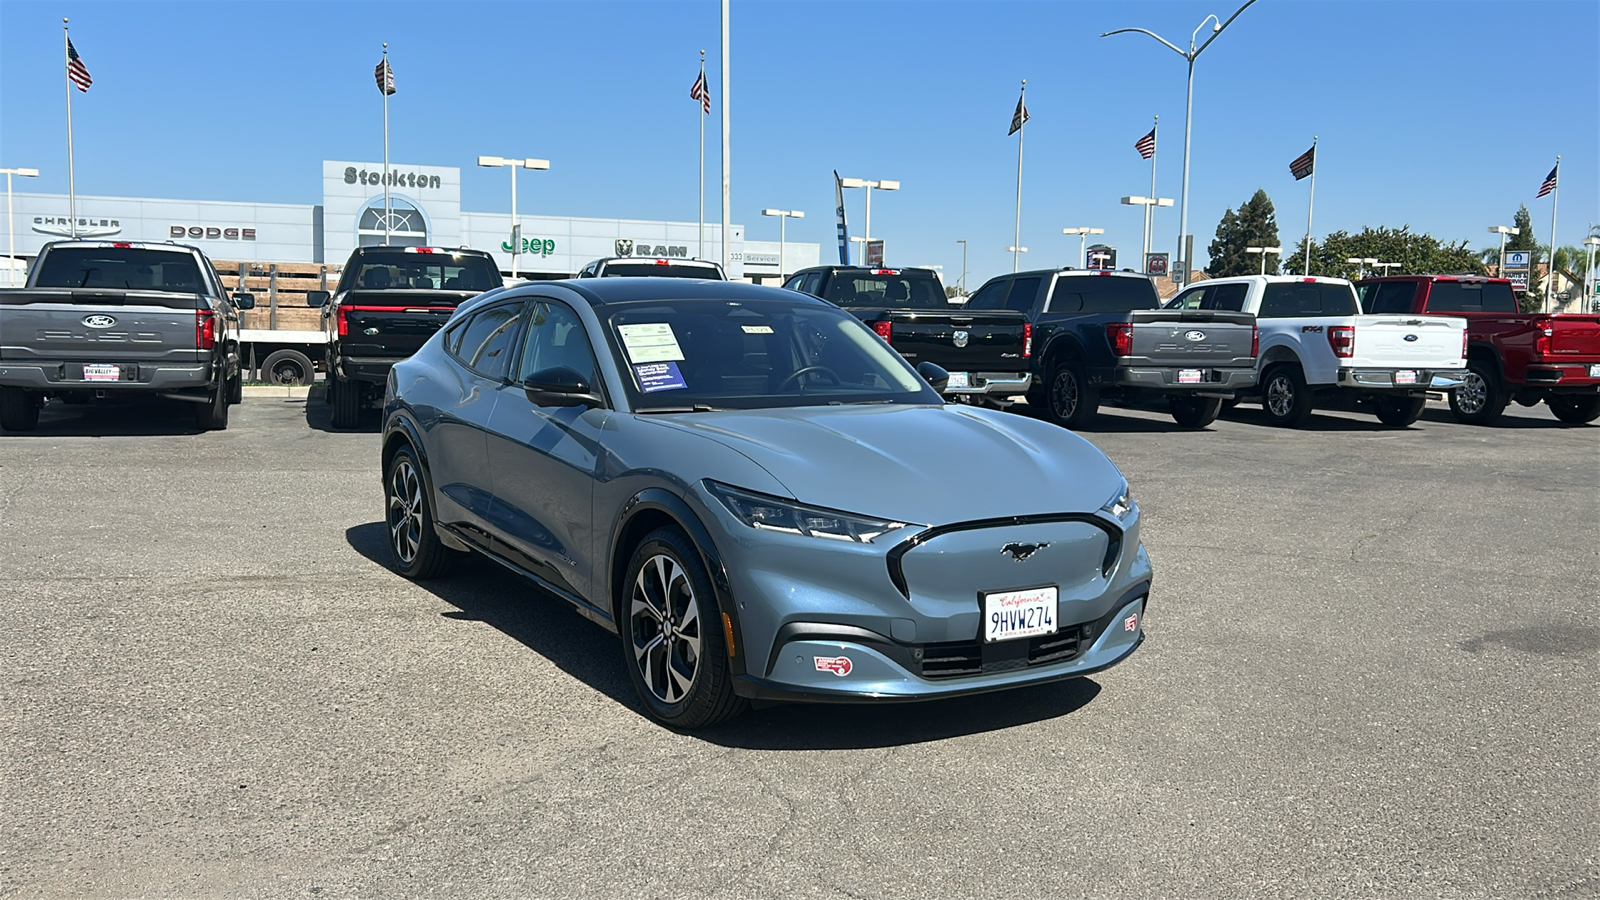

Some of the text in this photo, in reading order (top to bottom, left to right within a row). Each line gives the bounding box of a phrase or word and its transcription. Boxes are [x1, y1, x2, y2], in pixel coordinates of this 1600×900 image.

[344, 166, 442, 189] Stockton
[33, 216, 120, 227] CHRYSLER
[170, 226, 257, 240] DODGE
[636, 244, 688, 257] RAM
[730, 252, 742, 260] 333
[746, 254, 776, 262] Service
[36, 329, 163, 343] F-150
[1001, 593, 1044, 607] California
[991, 606, 1052, 634] 9HVW274
